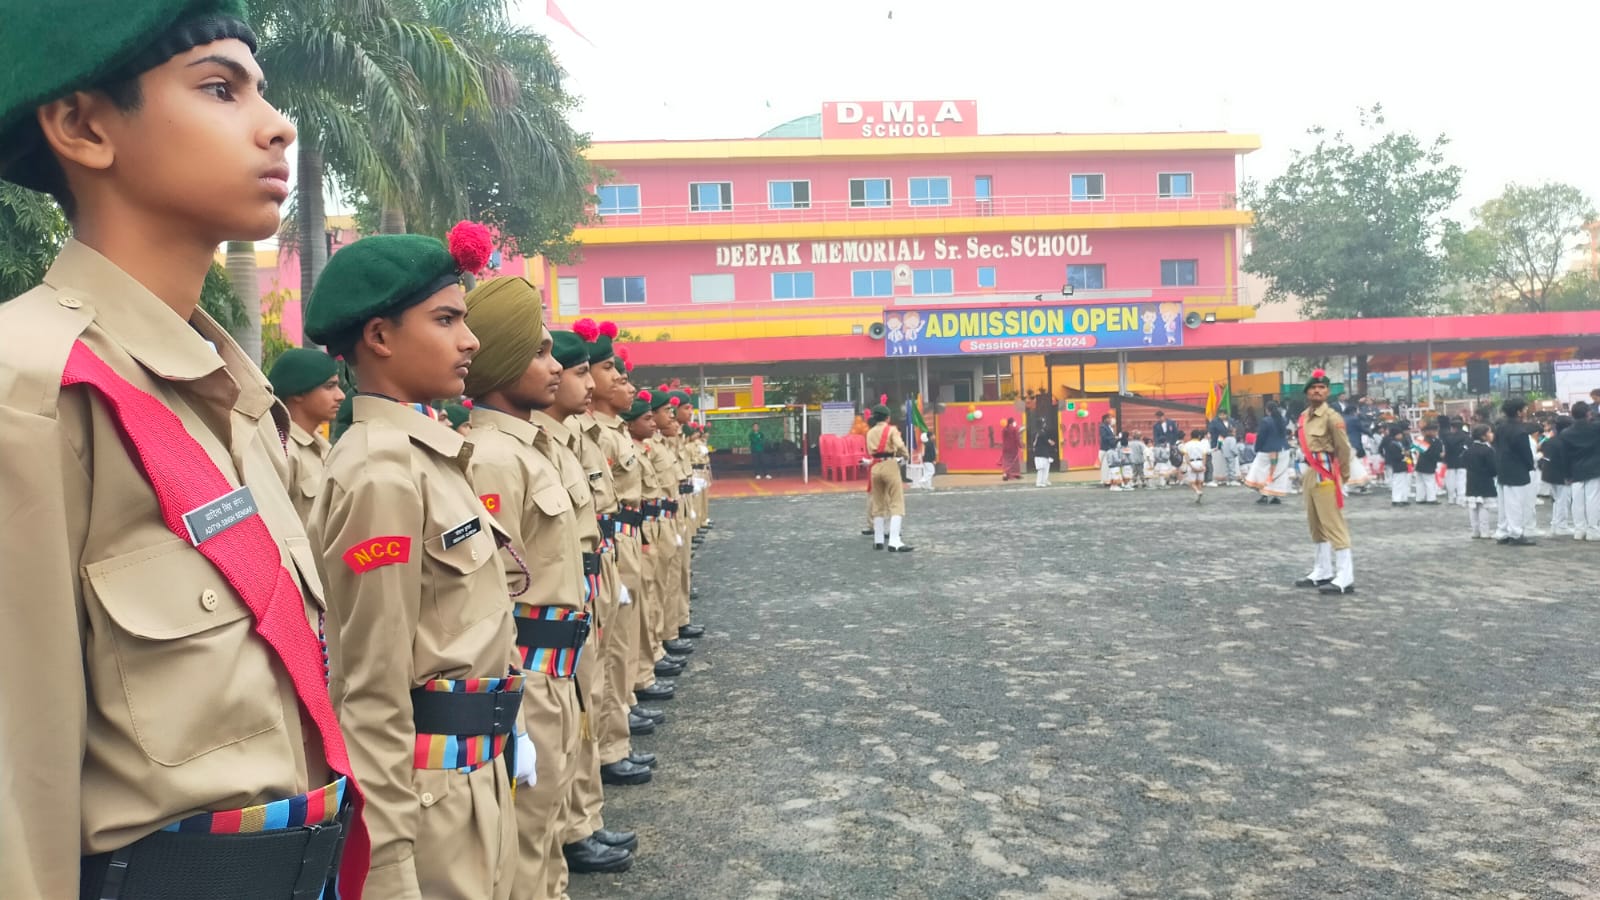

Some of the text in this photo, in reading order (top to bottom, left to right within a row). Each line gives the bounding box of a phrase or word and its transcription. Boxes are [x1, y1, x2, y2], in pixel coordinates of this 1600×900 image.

[861, 123, 941, 137] SCHOOL
[716, 243, 802, 267] DEEPAK
[811, 239, 925, 264] MEMORIAL
[934, 237, 962, 260] Sr.
[925, 306, 1139, 338] ADMISSION OPEN
